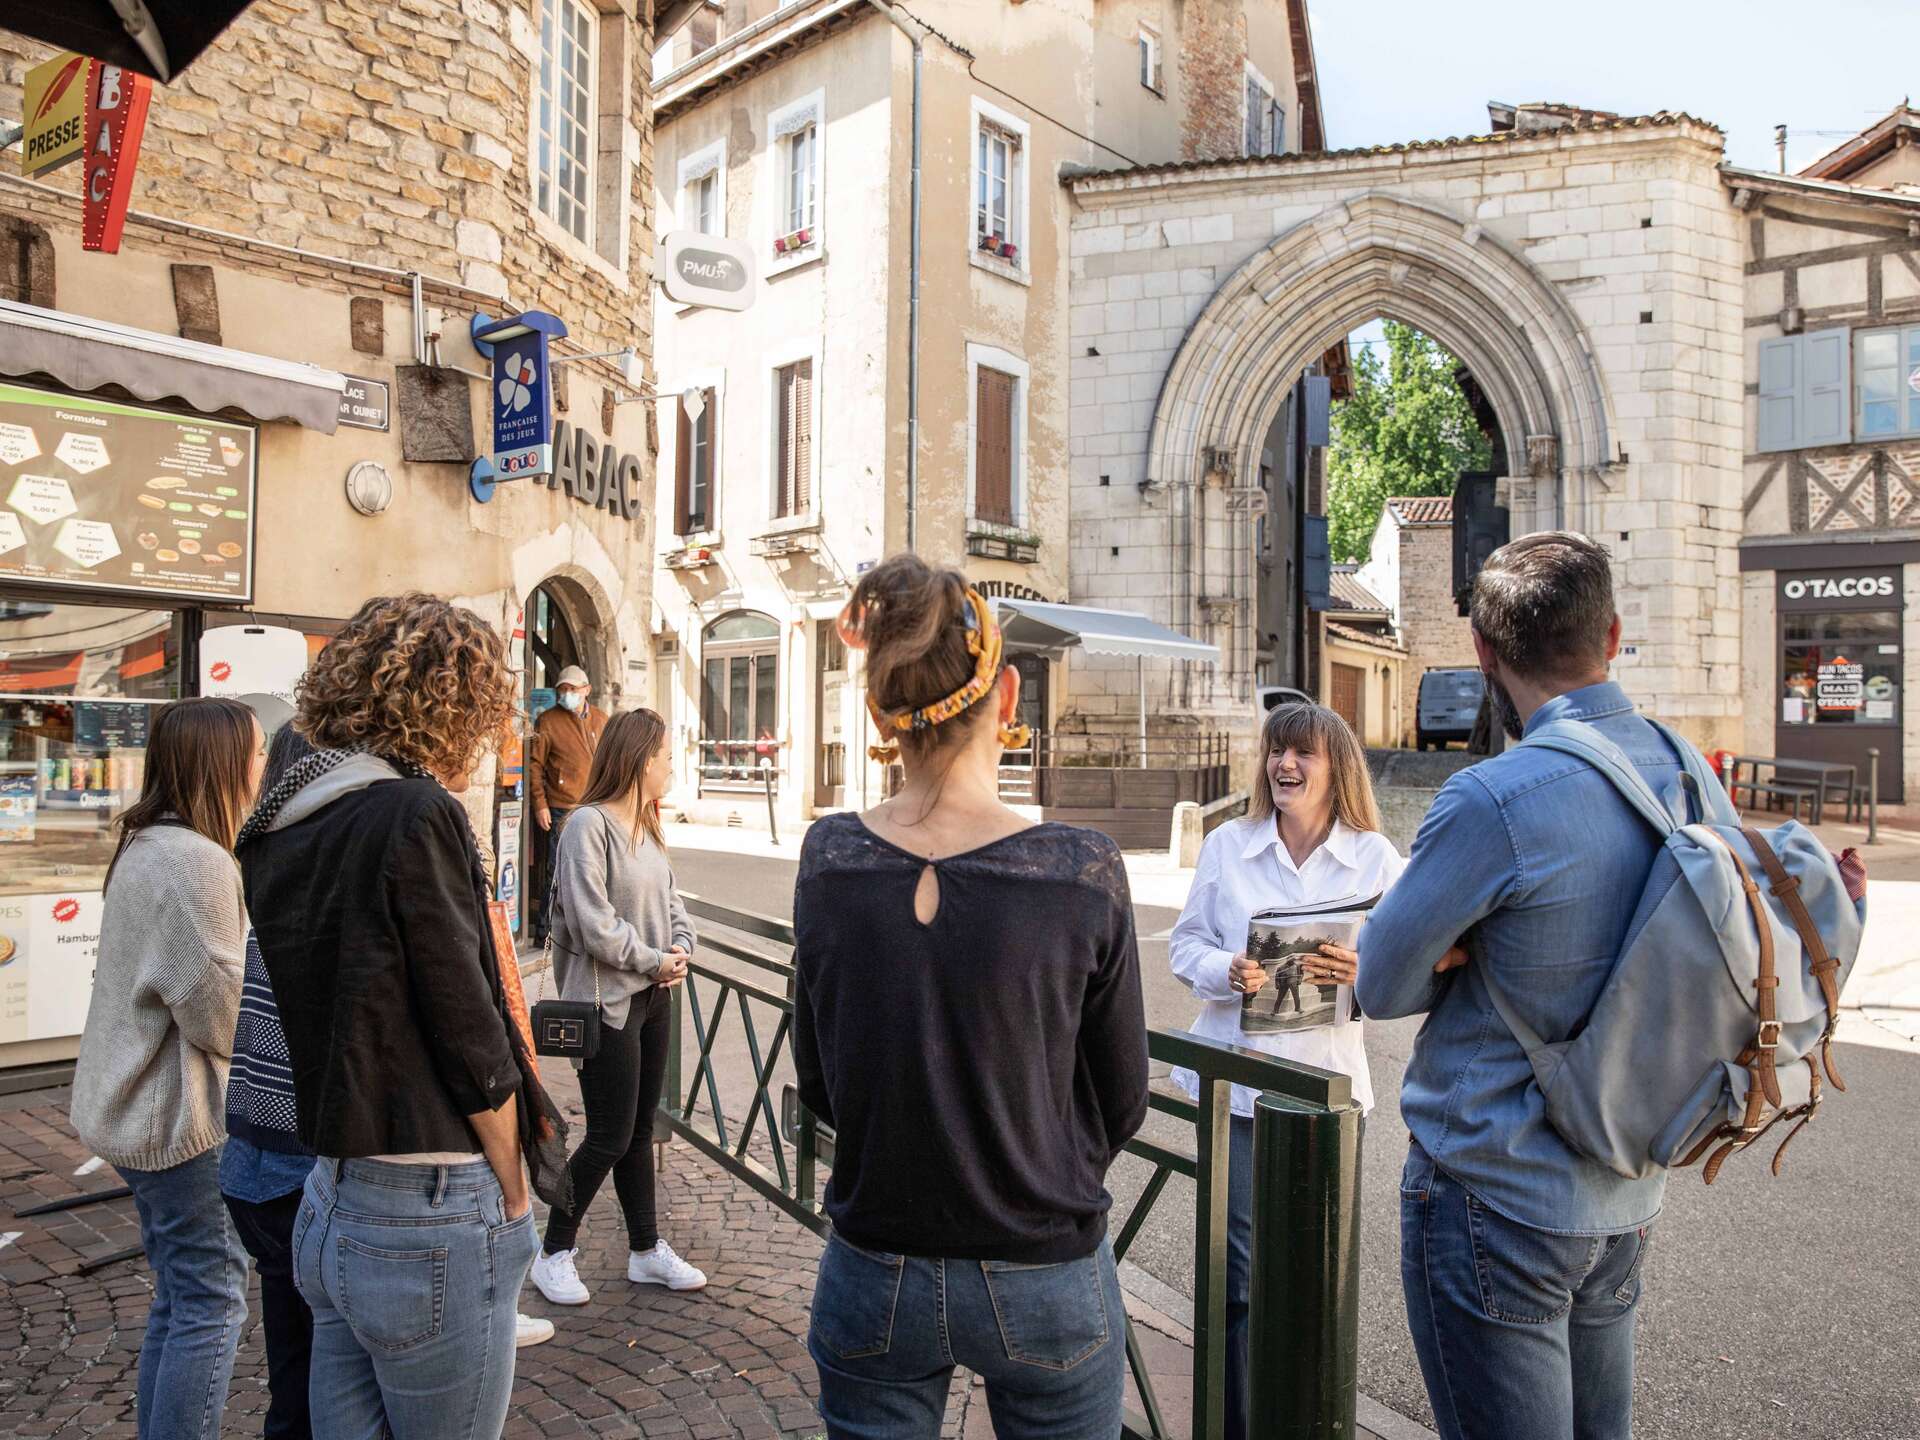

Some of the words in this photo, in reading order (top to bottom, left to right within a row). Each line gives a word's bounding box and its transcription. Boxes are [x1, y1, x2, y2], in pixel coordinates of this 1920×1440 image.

[28, 115, 80, 161] PRESSE
[683, 260, 717, 278] PMU
[56, 411, 107, 426] Formules
[352, 405, 382, 419] QUINET
[499, 415, 538, 431] FRANÇAISE
[501, 431, 515, 443] DES
[517, 428, 536, 441] JEUX
[500, 451, 539, 473] LOTO
[533, 419, 643, 521] ABAC
[1784, 576, 1894, 599] O'TACOS
